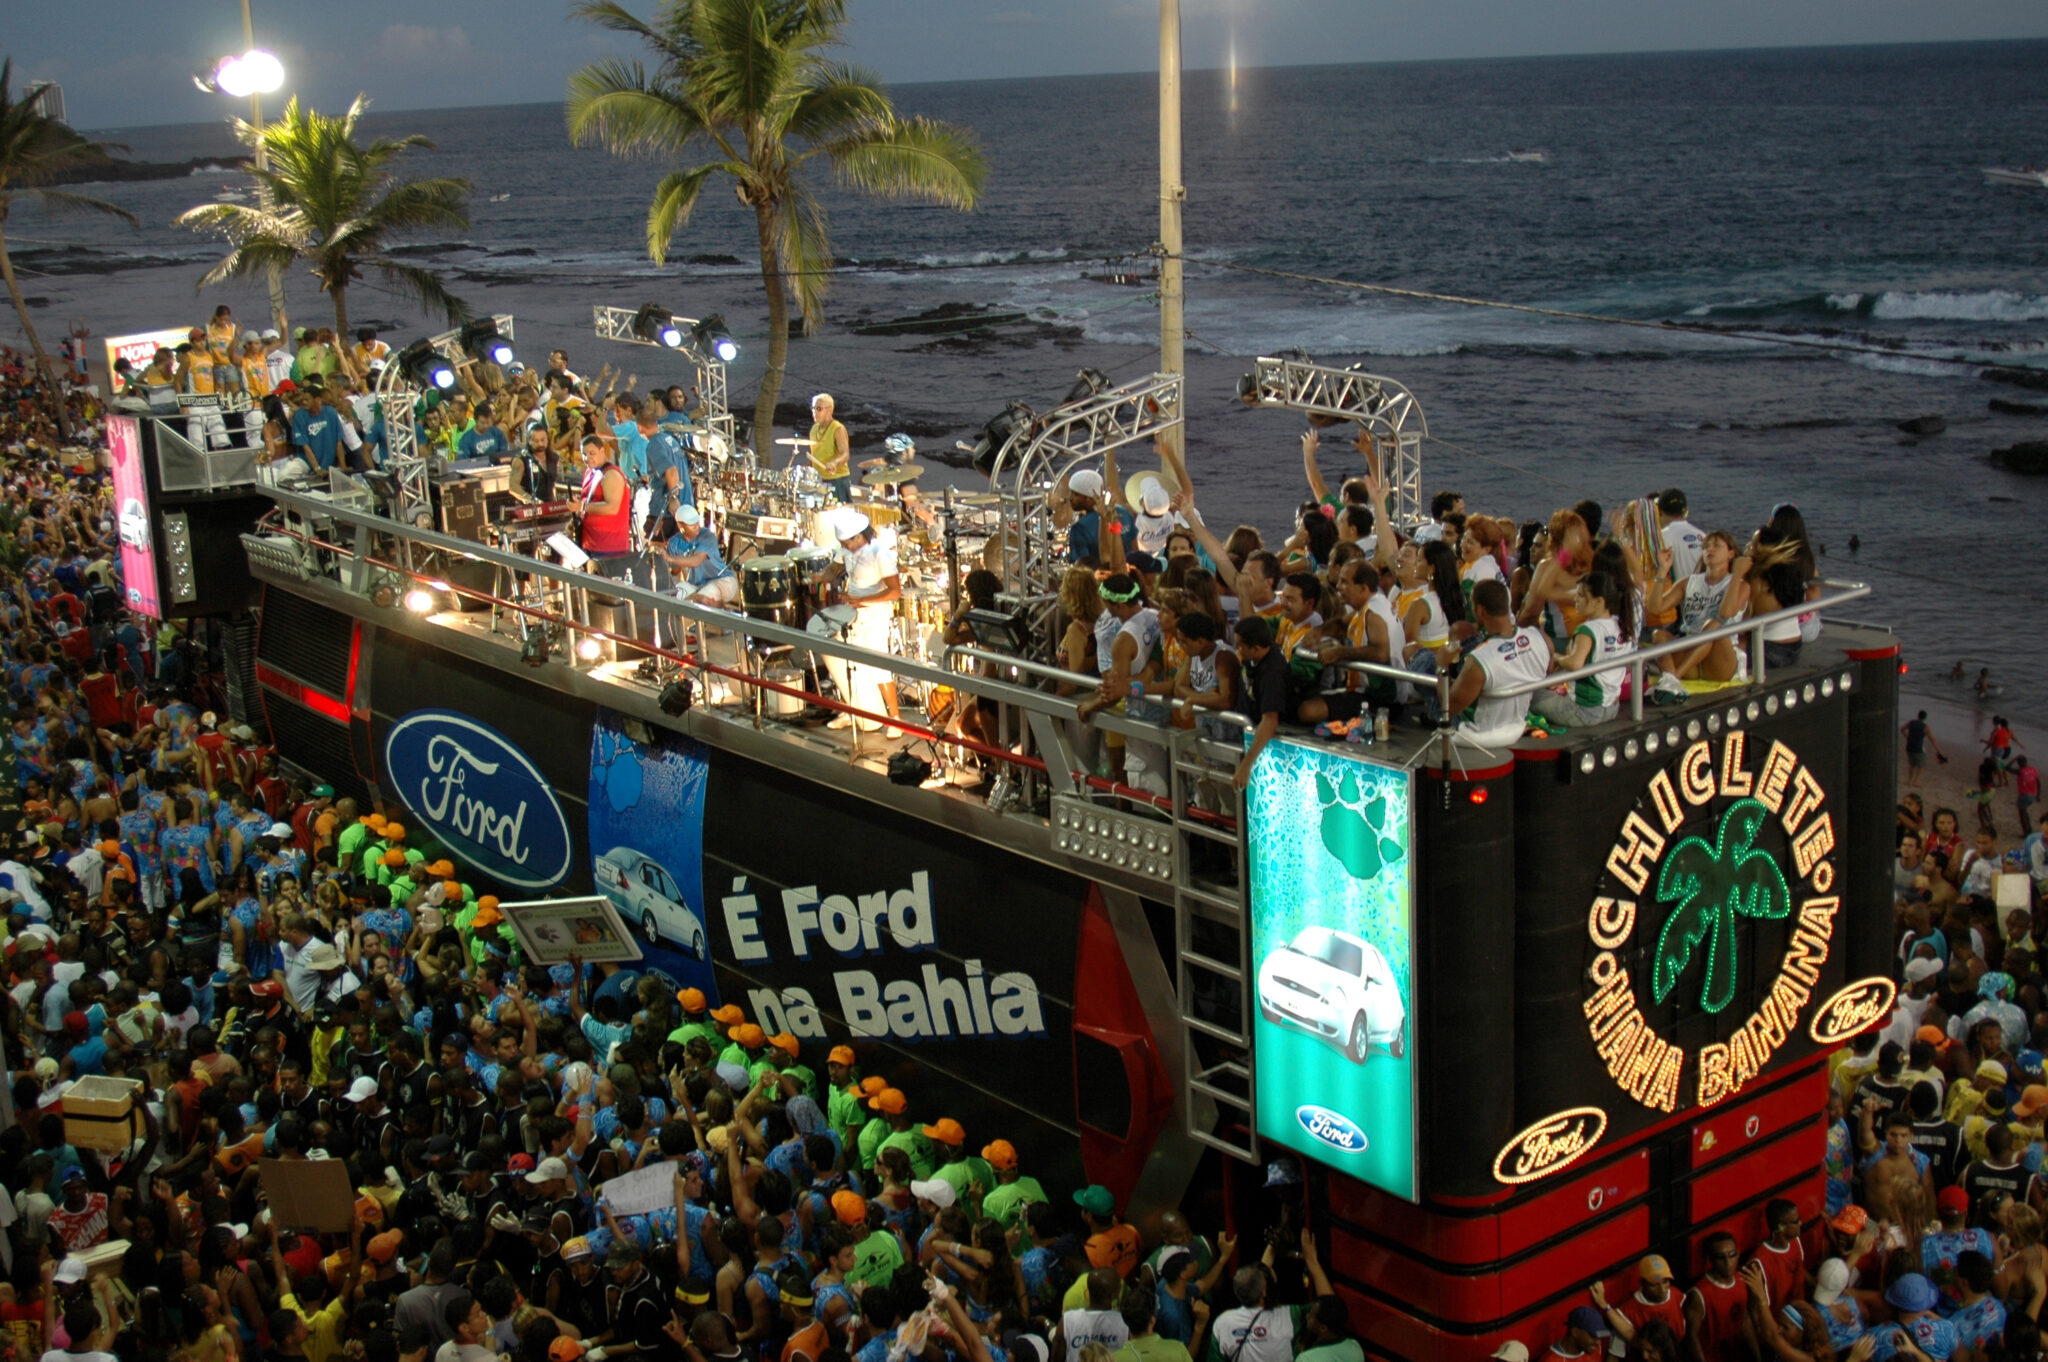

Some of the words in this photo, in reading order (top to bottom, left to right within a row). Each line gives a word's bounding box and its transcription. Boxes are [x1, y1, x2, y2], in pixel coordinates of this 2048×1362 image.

[120, 343, 156, 361] NOVA
[421, 734, 529, 865] Ford
[1588, 730, 1835, 949] CHICLETE
[721, 875, 768, 960] É
[781, 870, 935, 956] Ford
[747, 986, 827, 1038] na
[833, 959, 1045, 1038] Bahia
[1699, 896, 1840, 1108] BANANA
[1827, 986, 1880, 1036] Ford
[1309, 1110, 1354, 1148] Ford
[1515, 1118, 1585, 1176] Ford
